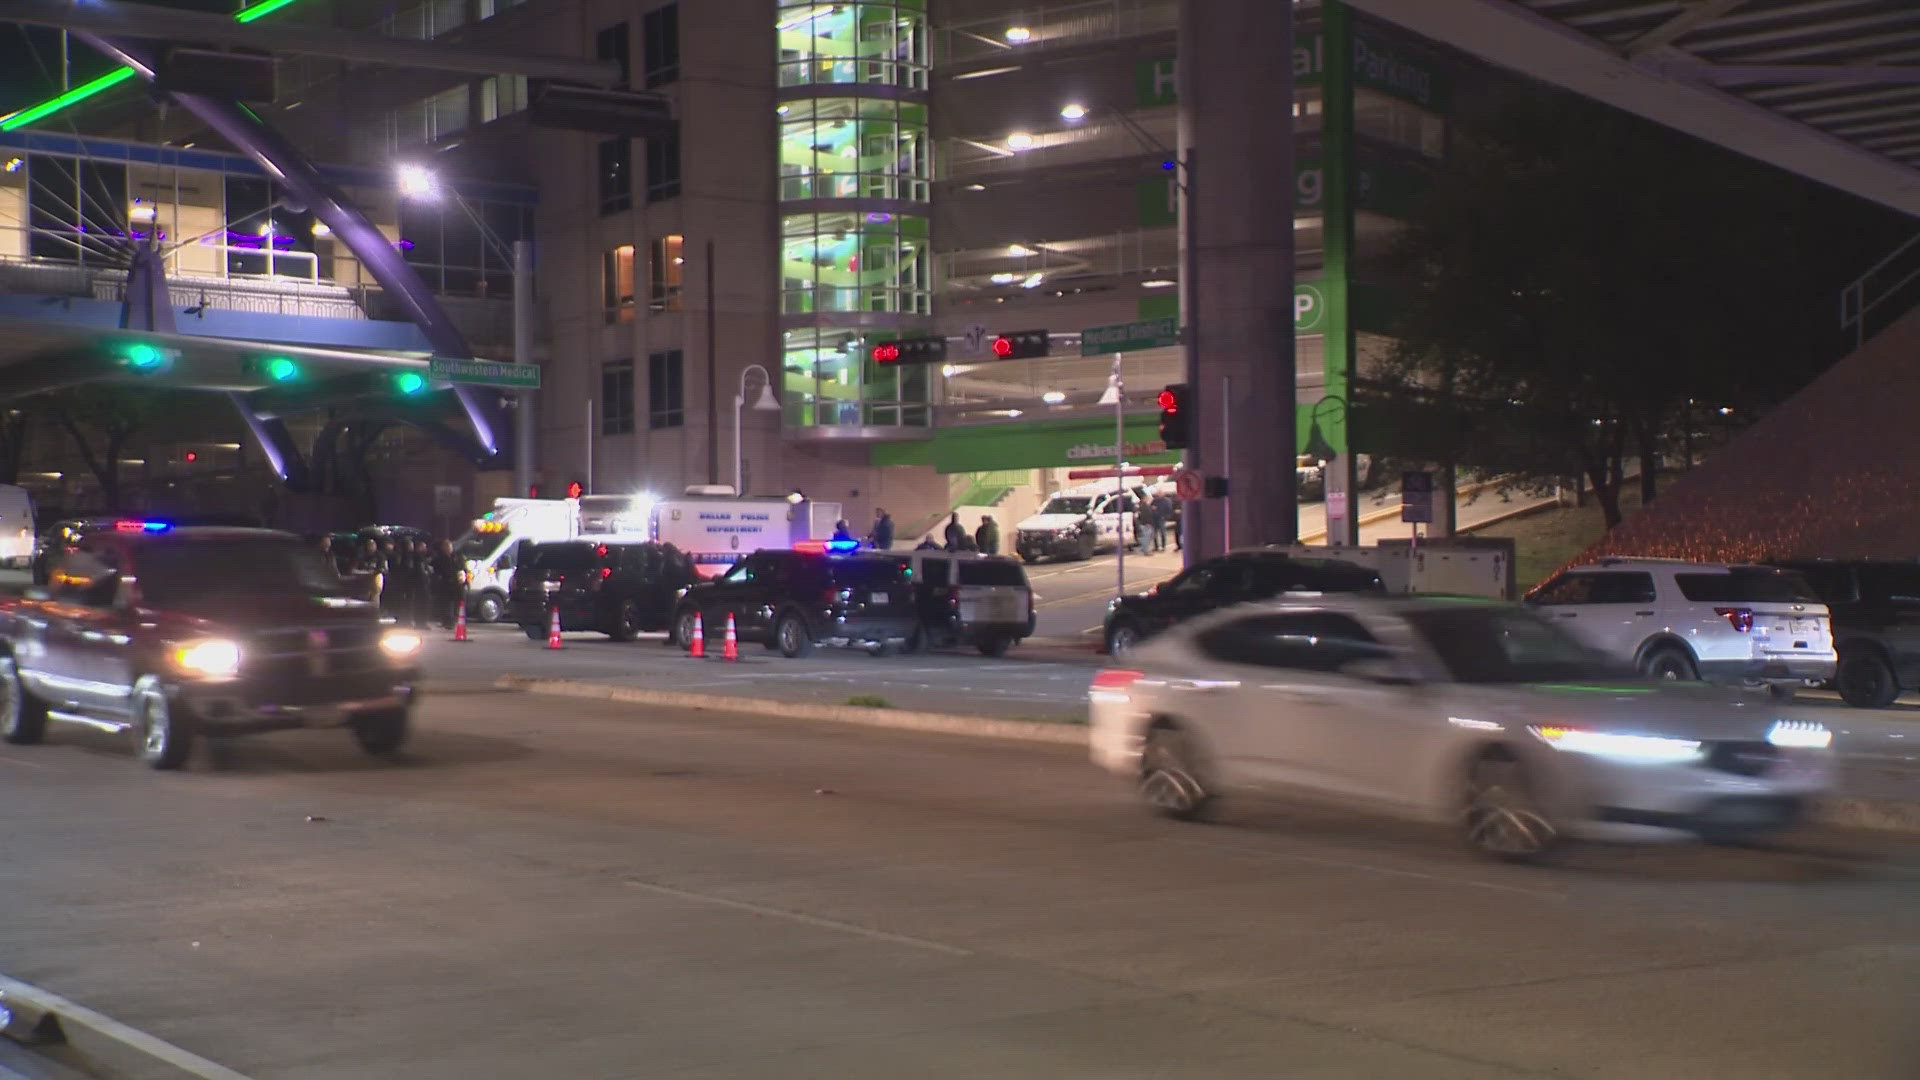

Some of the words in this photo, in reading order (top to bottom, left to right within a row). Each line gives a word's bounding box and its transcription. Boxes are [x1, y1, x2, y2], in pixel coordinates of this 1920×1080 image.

[1354, 36, 1430, 103] Parking
[1294, 294, 1313, 321] P
[433, 360, 499, 377] Southwestern
[500, 365, 536, 379] Medical
[699, 512, 731, 521] DALLAS
[740, 512, 769, 521] POLICE
[706, 525, 763, 533] DEPARTMENT
